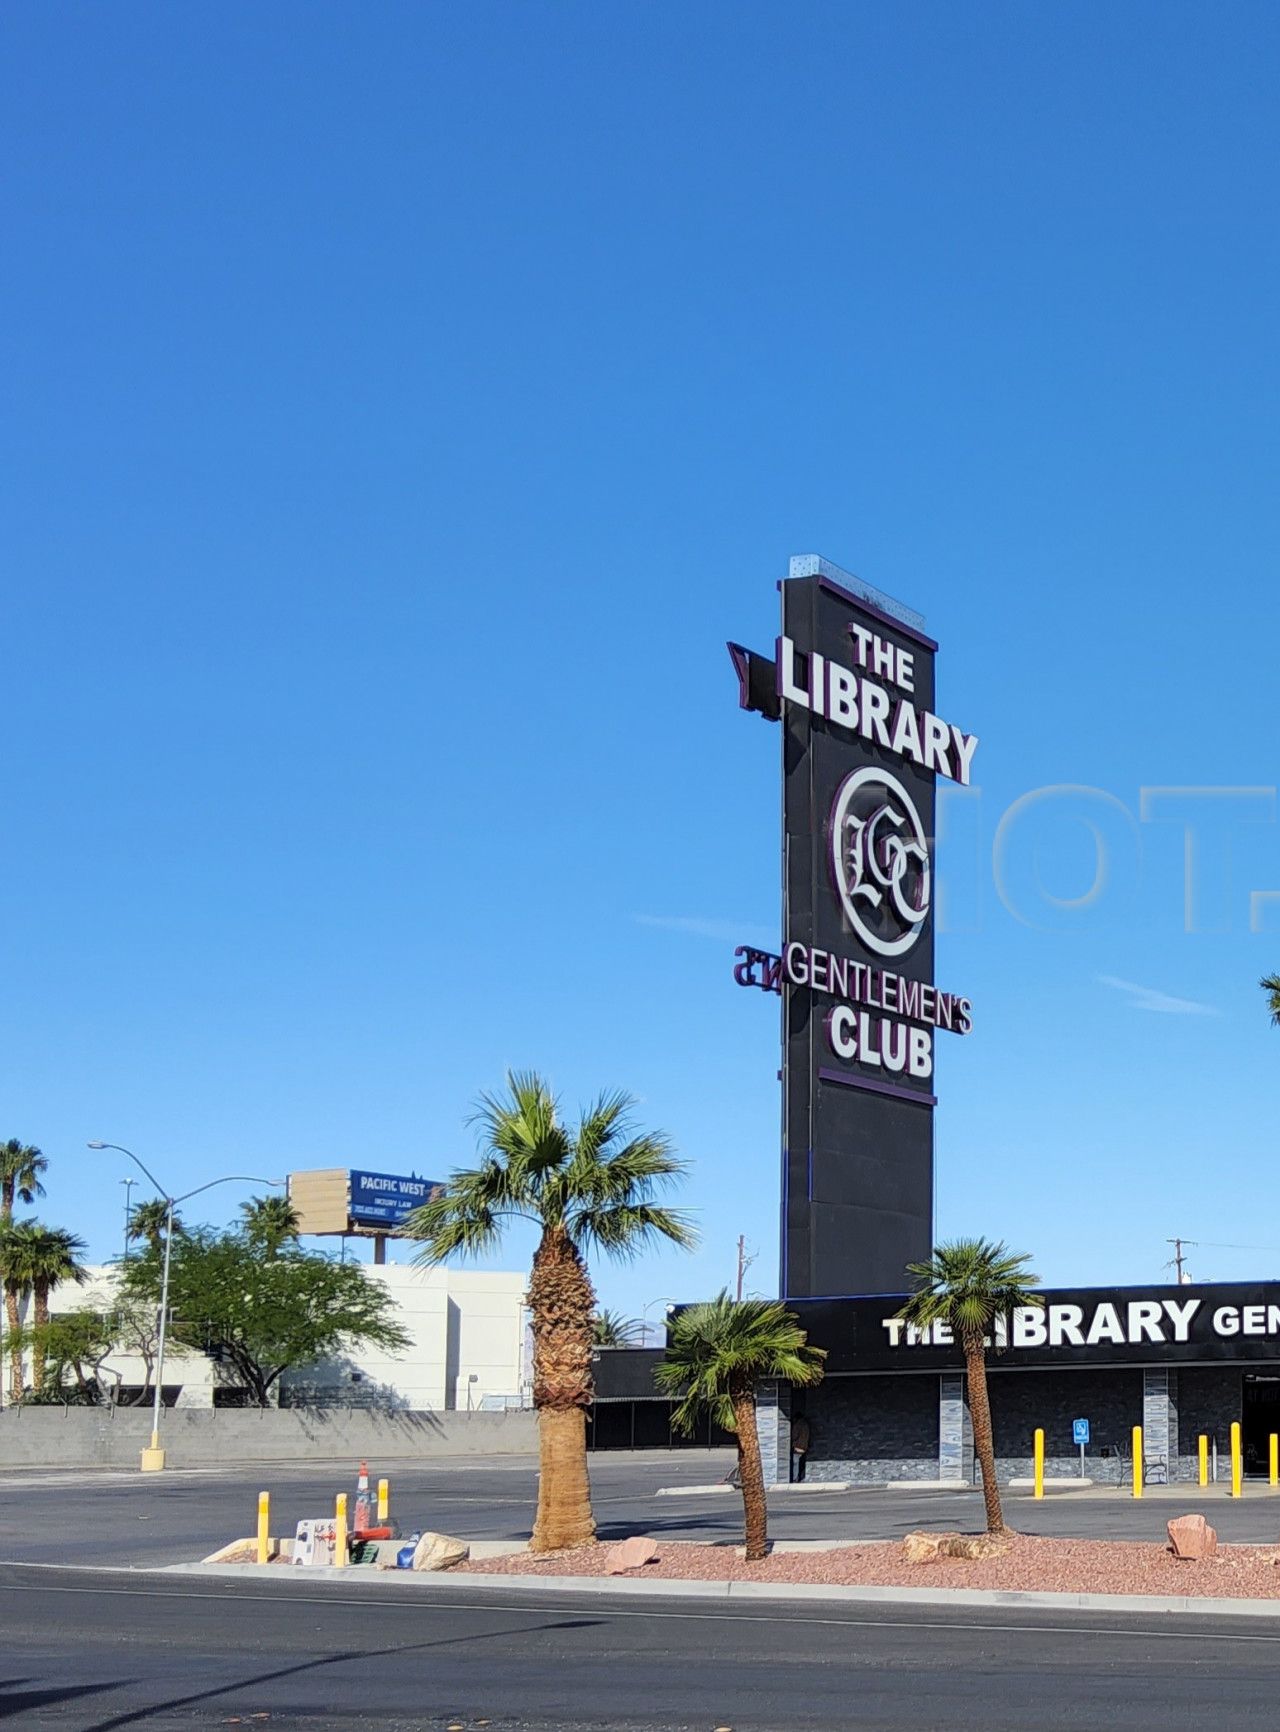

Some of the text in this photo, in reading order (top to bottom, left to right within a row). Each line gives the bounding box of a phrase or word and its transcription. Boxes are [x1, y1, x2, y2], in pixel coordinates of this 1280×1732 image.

[848, 622, 914, 693] THE
[776, 635, 979, 786] LIBRARY
[784, 942, 973, 1035] GENTLEMEN'S
[825, 1005, 932, 1078] CLUB
[361, 1176, 425, 1196] PACIFIC WEST
[980, 1298, 1201, 1348] IBRARY
